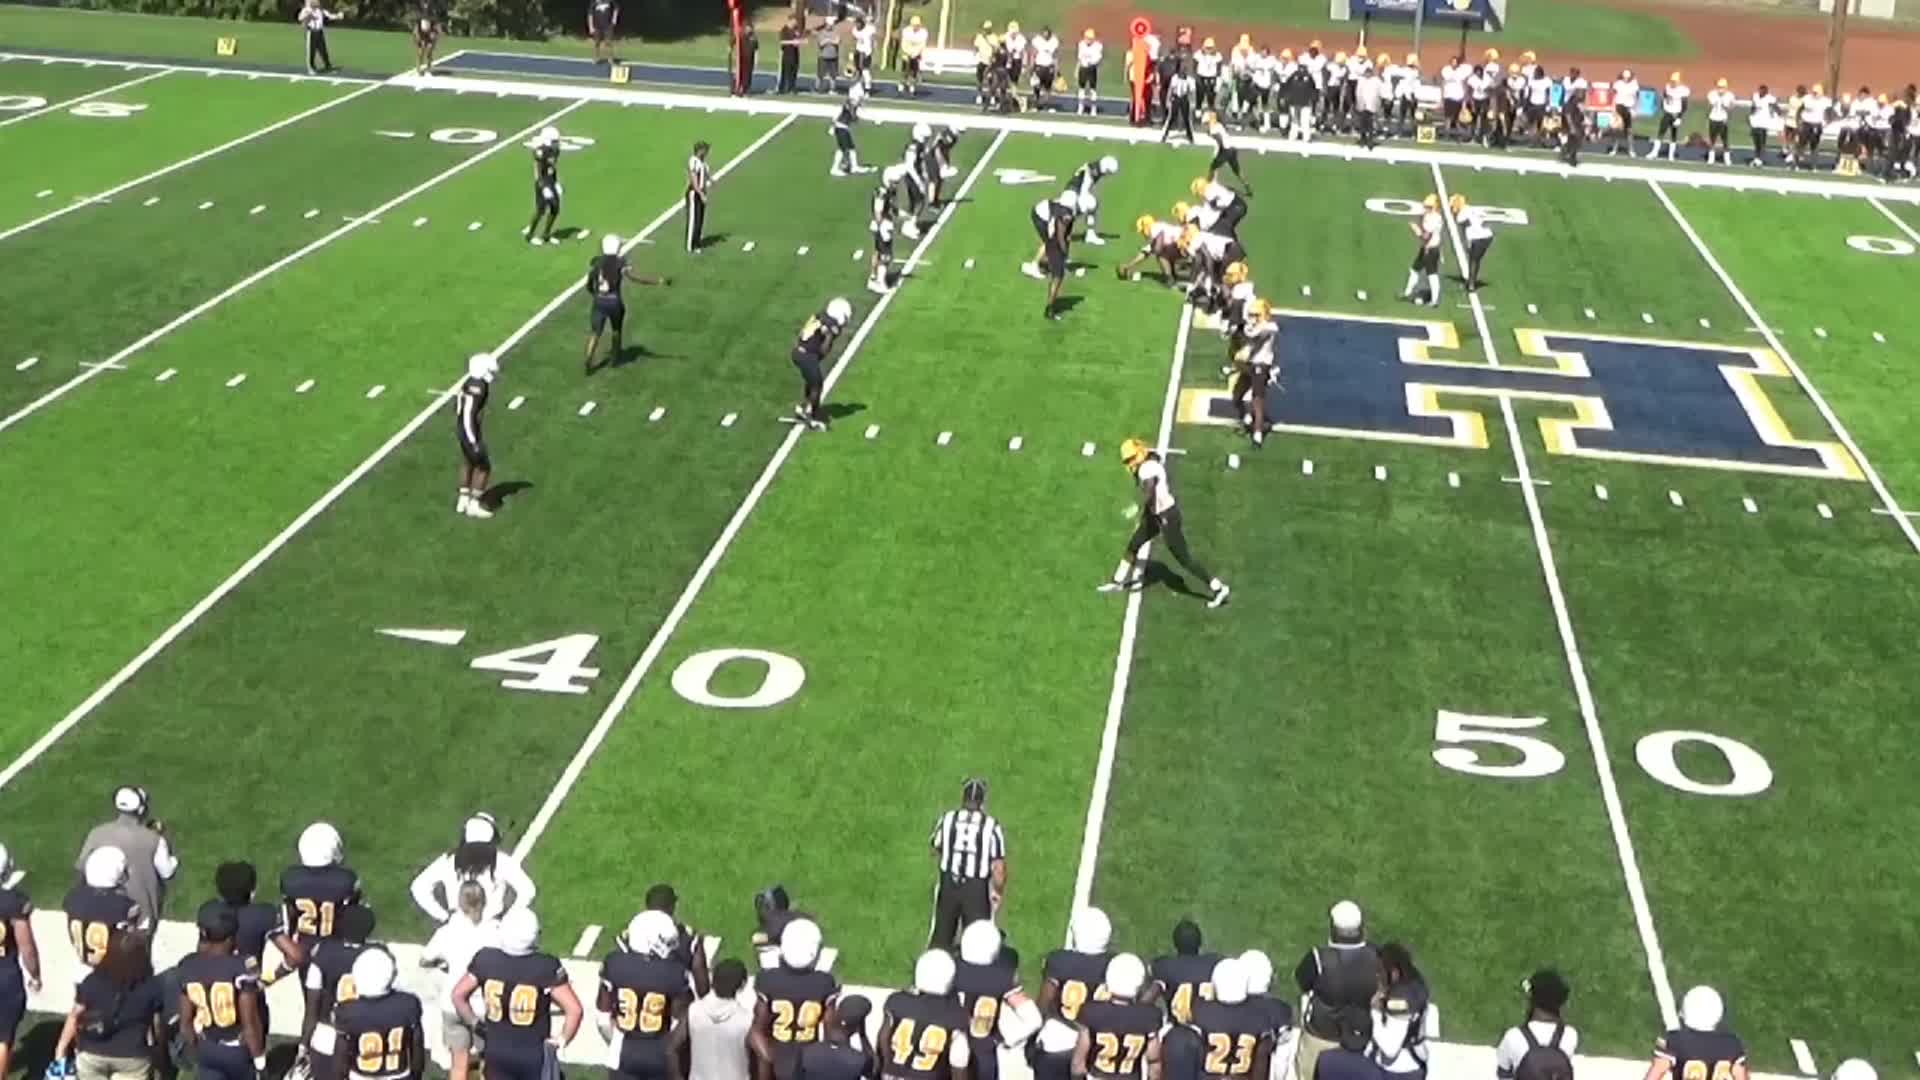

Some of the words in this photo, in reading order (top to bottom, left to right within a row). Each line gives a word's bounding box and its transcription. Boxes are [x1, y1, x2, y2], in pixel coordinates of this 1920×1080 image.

[295, 898, 336, 937] 21
[70, 919, 110, 967] 19
[771, 999, 823, 1042] 29
[891, 1018, 948, 1071] 49
[1094, 1031, 1146, 1074] 27
[1204, 1032, 1257, 1075] 23
